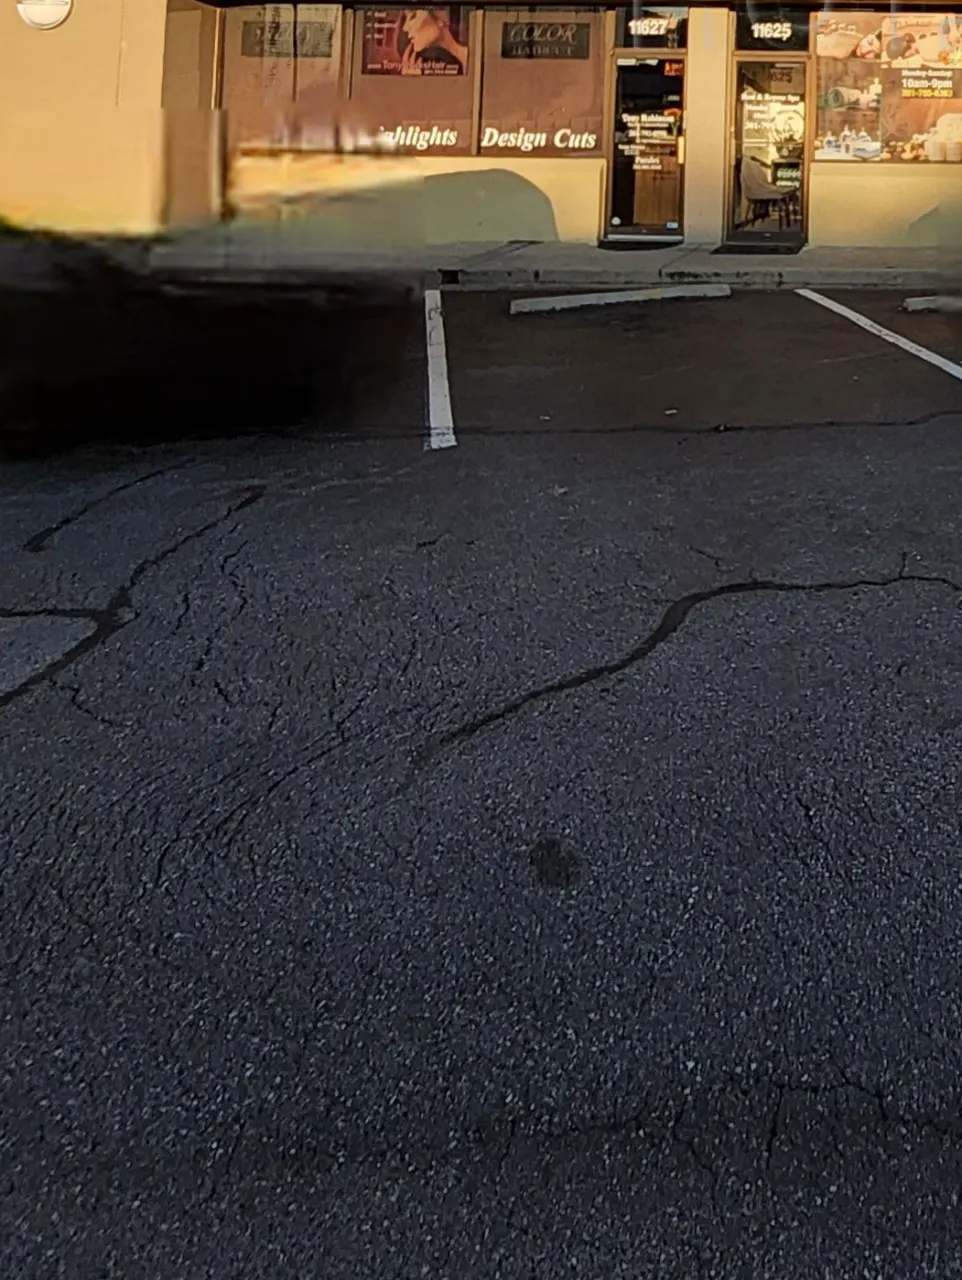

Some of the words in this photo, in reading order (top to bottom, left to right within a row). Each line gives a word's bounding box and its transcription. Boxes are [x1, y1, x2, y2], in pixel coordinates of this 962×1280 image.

[628, 20, 668, 35] 11627
[751, 22, 792, 40] 11625
[481, 127, 546, 151] Design
[554, 128, 597, 148] Cuts
